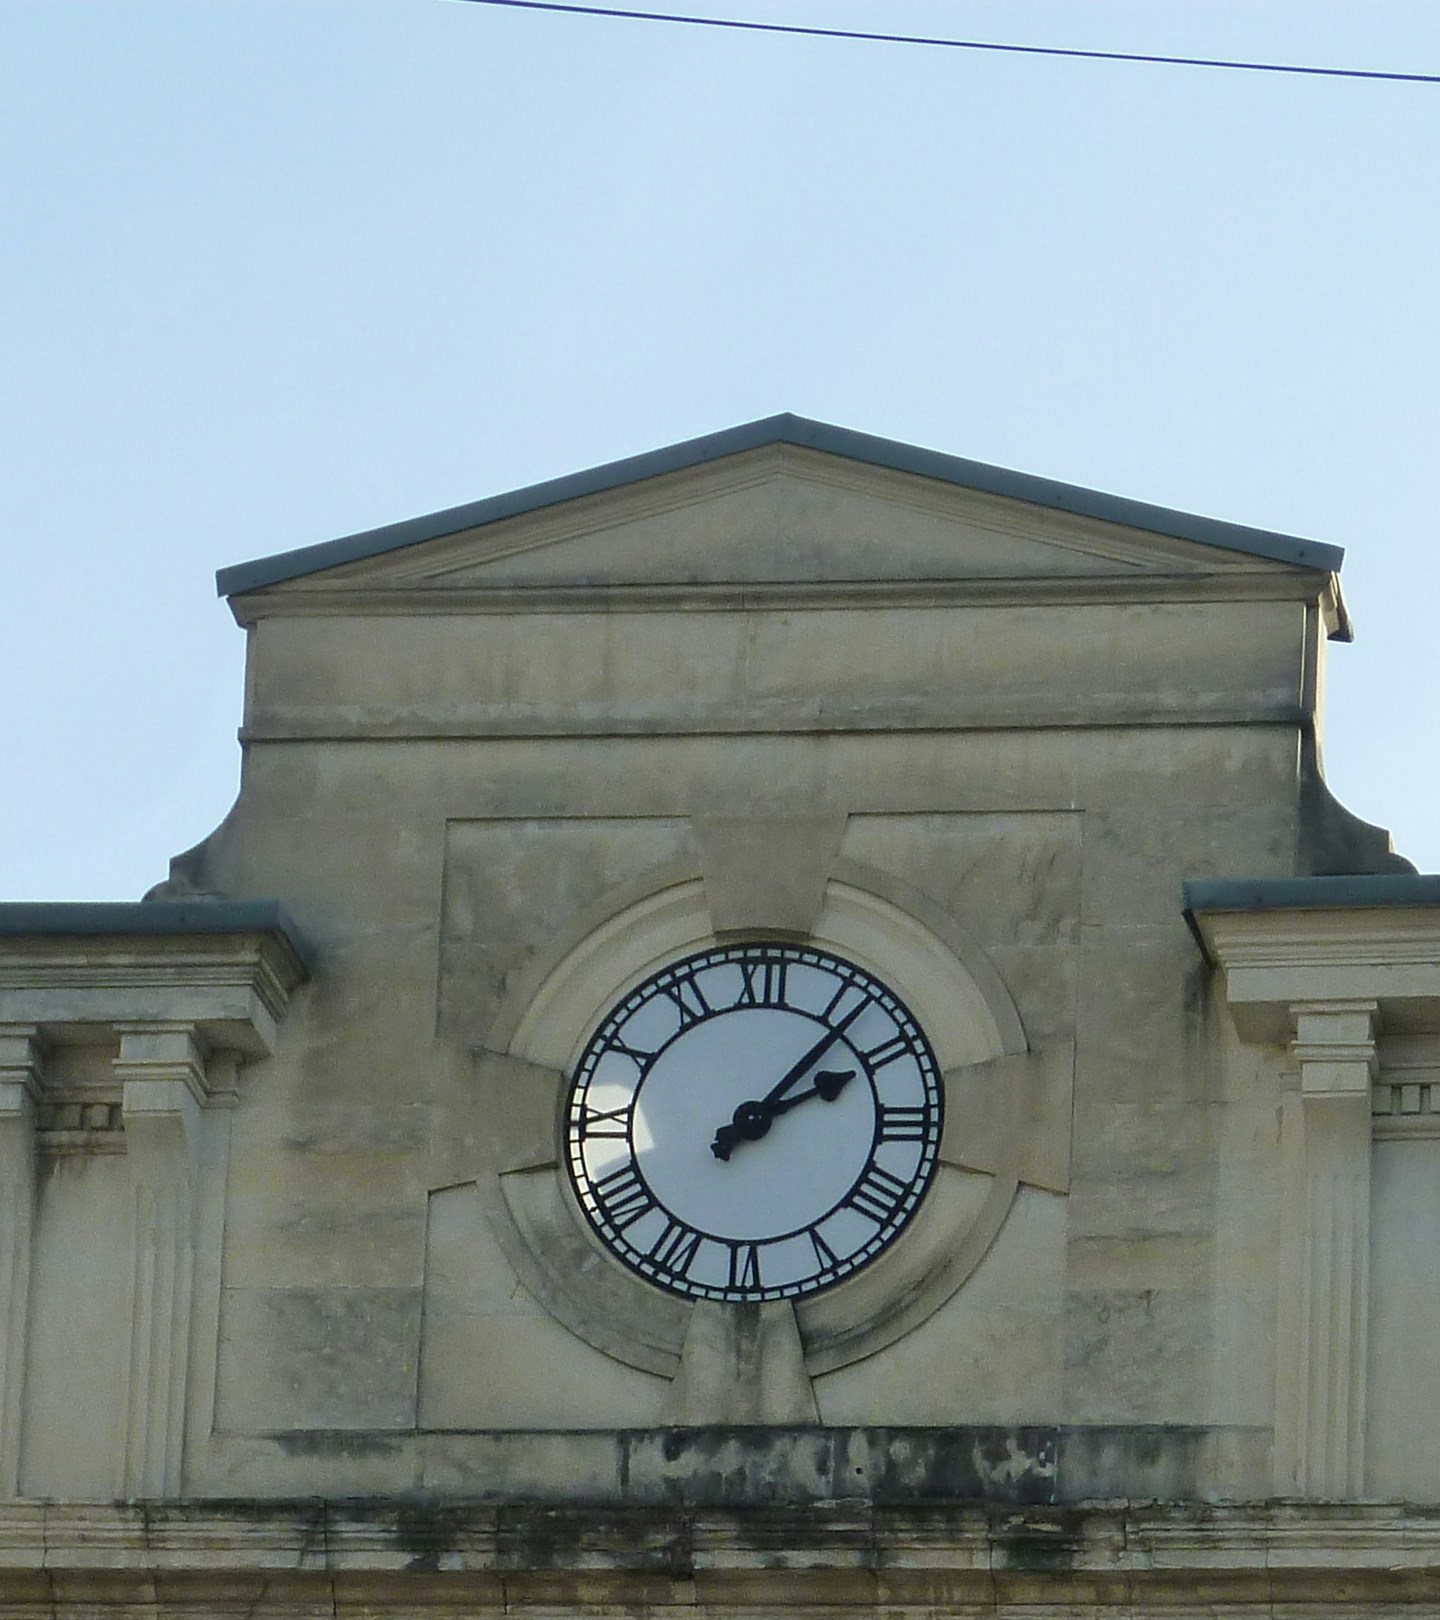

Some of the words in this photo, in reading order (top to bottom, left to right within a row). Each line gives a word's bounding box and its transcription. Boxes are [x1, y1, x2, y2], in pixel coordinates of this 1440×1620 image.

[733, 958, 790, 1009] XII
[858, 1028, 918, 1078] II
[875, 1103, 930, 1144] III
